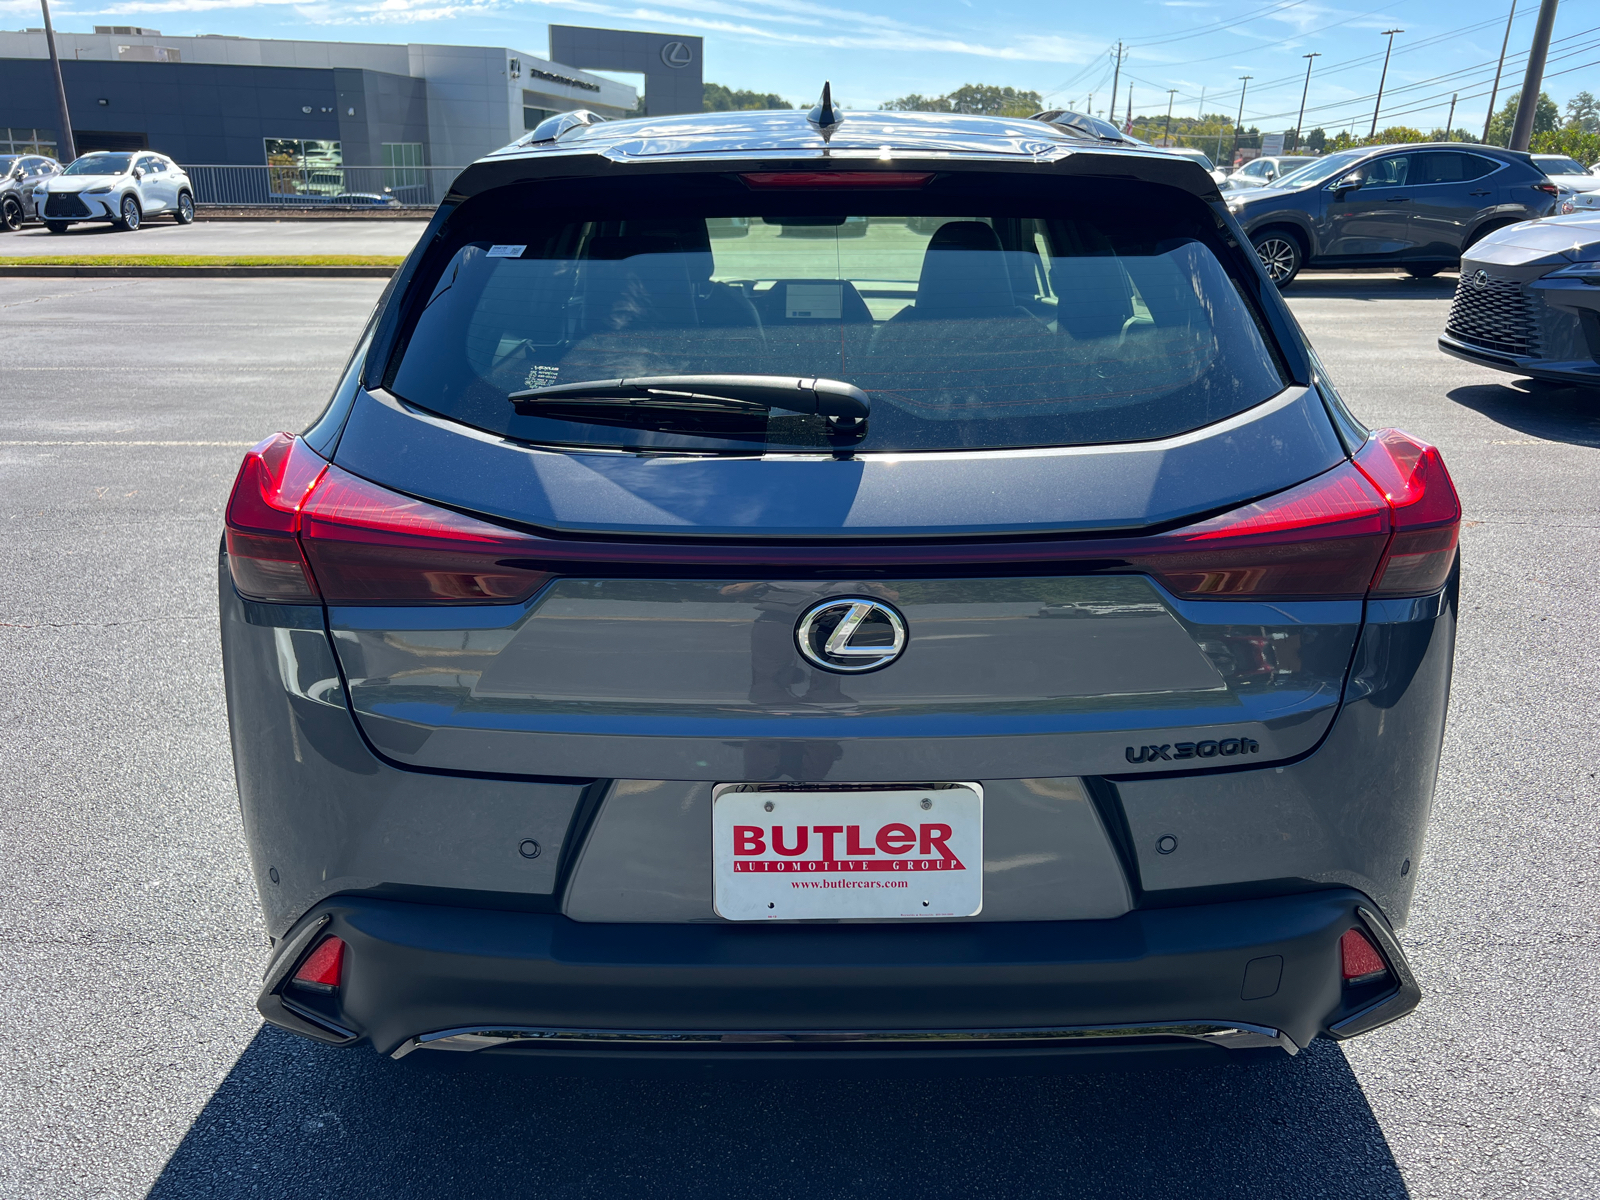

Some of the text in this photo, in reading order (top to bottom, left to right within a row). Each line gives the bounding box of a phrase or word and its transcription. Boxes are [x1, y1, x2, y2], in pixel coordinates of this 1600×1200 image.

[735, 860, 958, 872] AUTOMOTIVE GROUP
[790, 879, 909, 889] www.butlercars.com
